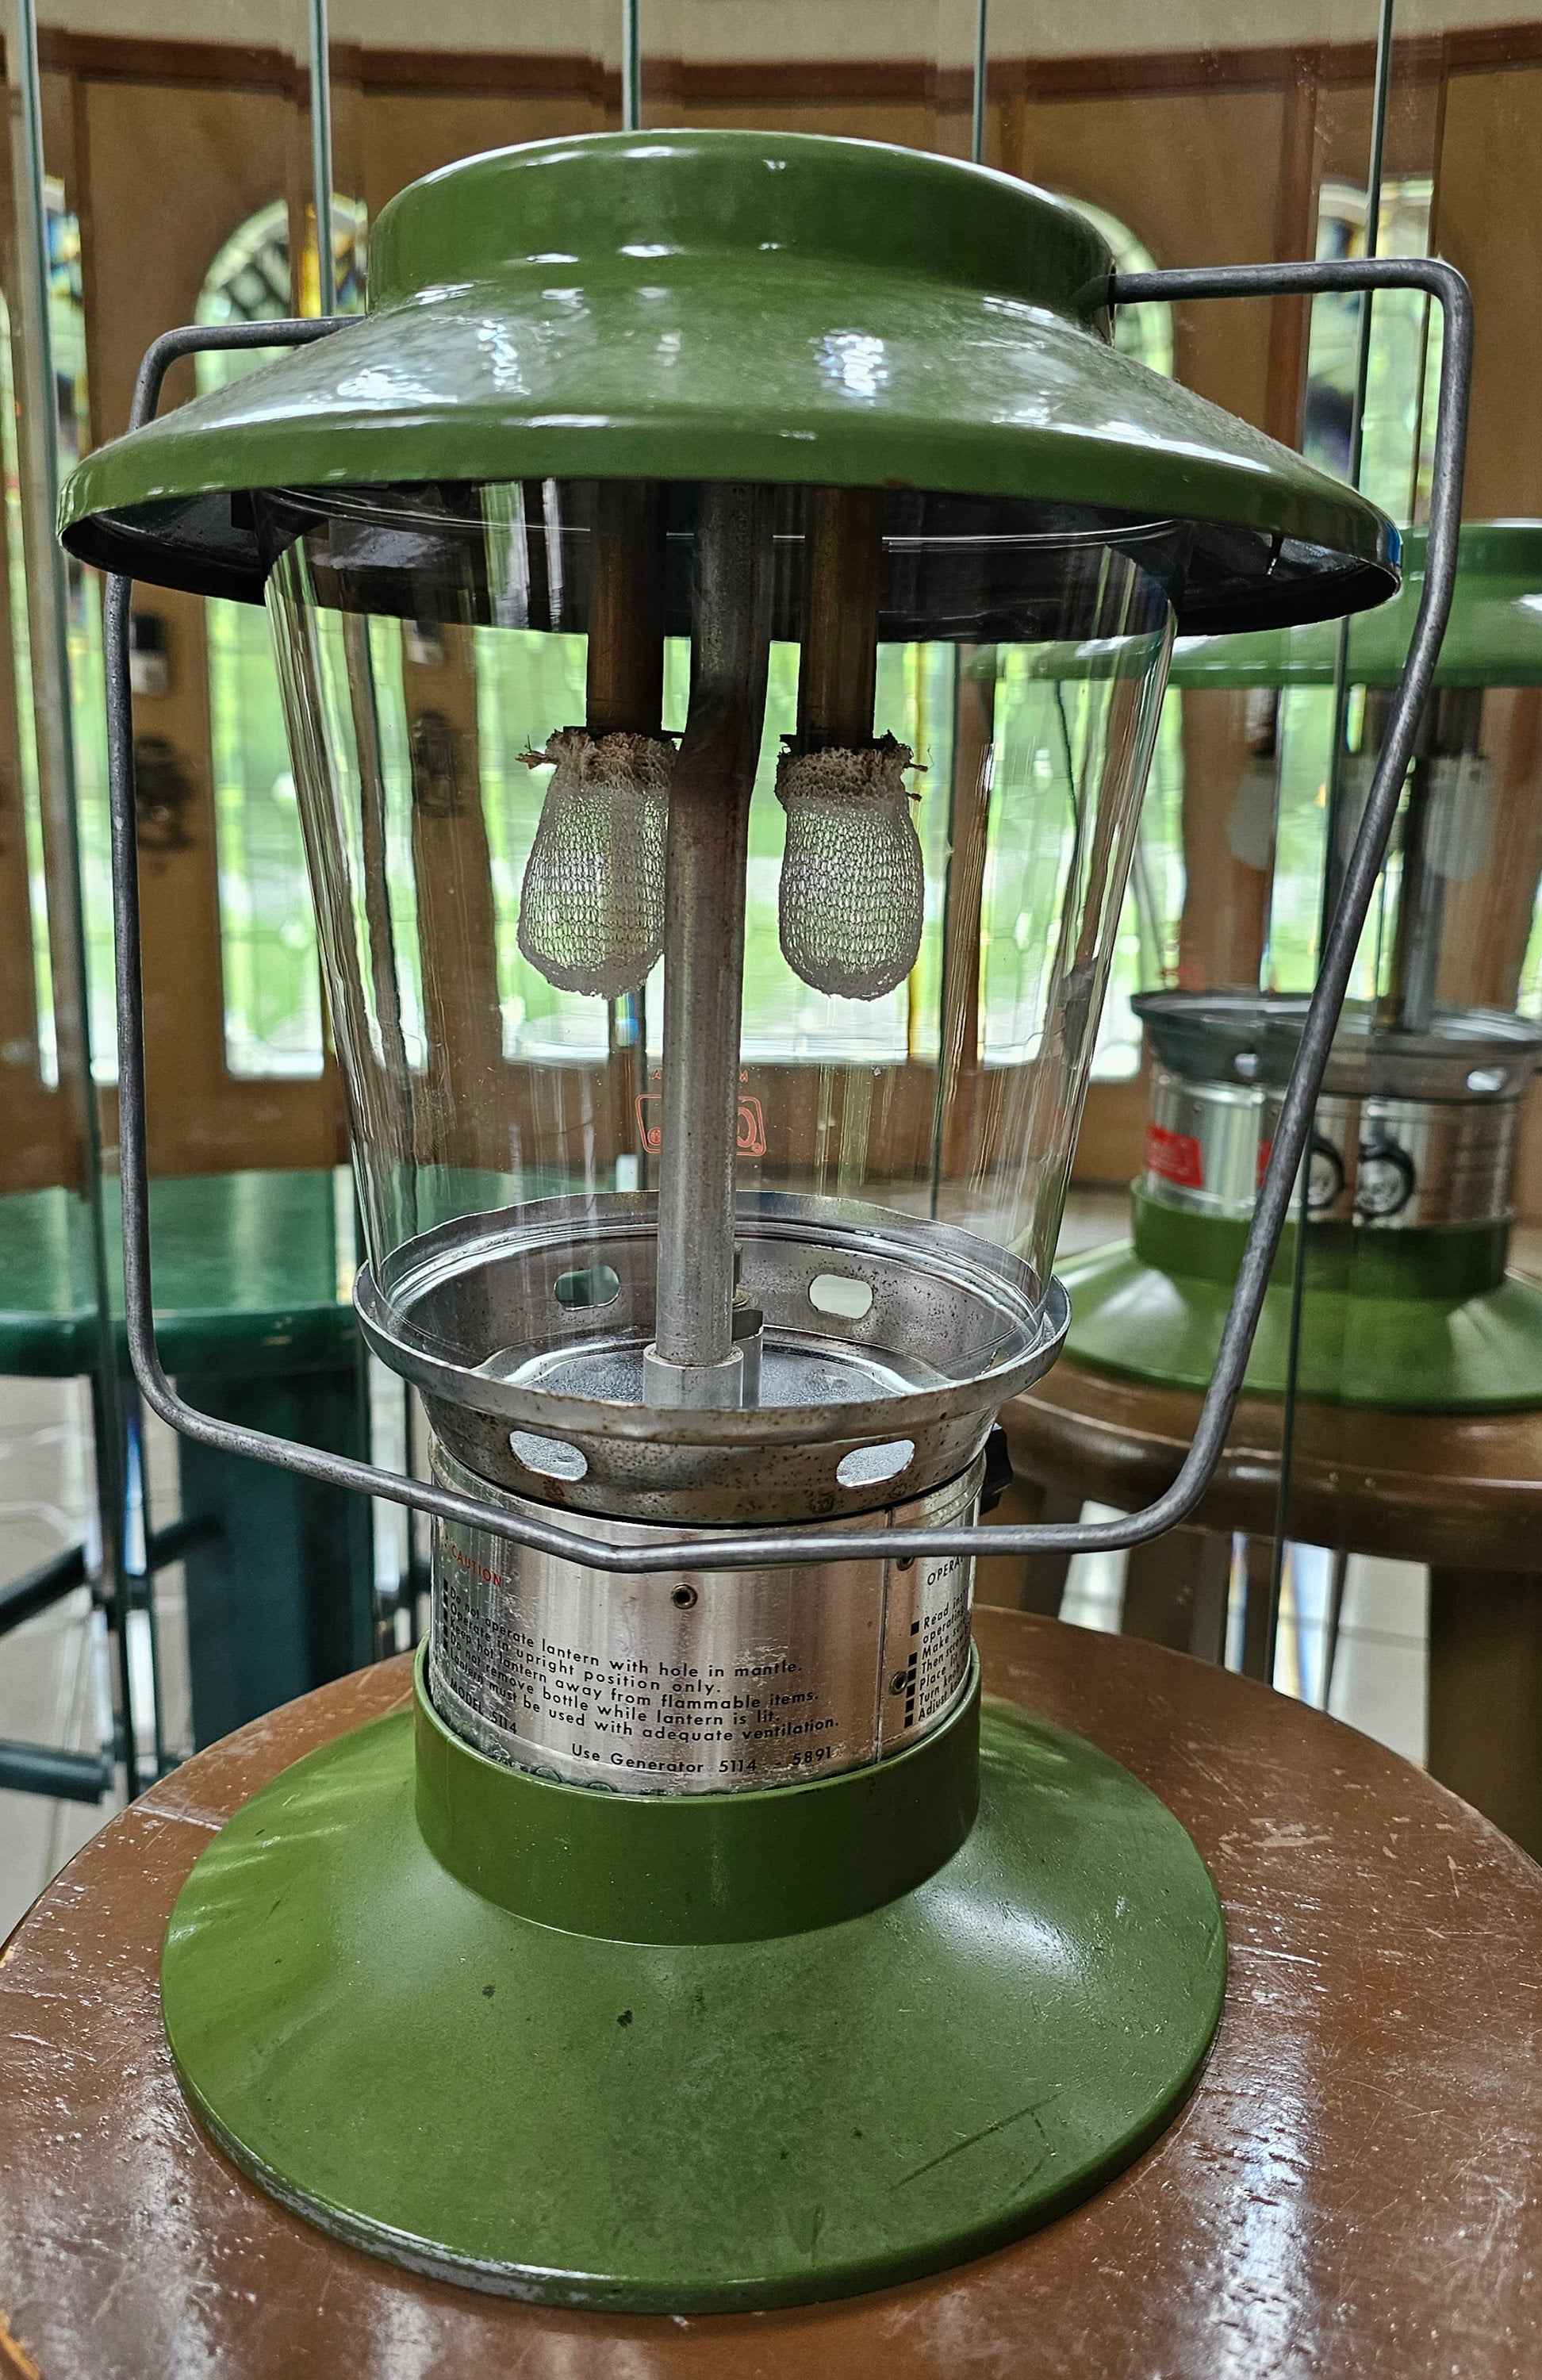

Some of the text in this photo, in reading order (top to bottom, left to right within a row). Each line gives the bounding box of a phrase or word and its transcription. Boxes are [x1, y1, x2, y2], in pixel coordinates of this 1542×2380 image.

[451, 1545, 501, 1587] CAUTION
[451, 1587, 802, 1677] Do not operate lantern with hole in mantle.
[923, 1602, 949, 1630] Read
[451, 1603, 721, 1695] Operate in upright position only.
[921, 1654, 943, 1674] Then
[922, 1635, 949, 1660] Make
[466, 1650, 481, 1667] not
[486, 1664, 534, 1695] remove
[543, 1686, 589, 1710] bottle
[597, 1704, 646, 1721] while
[657, 1710, 723, 1726] lantern
[733, 1712, 746, 1725] is
[757, 1710, 780, 1722] lit.
[500, 1651, 547, 1683] lantern
[555, 1679, 602, 1700] away
[611, 1688, 650, 1706] from
[662, 1694, 761, 1709] flammable
[769, 1691, 819, 1706] items.
[919, 1686, 940, 1706] Turn
[920, 1666, 946, 1691] Place
[451, 1678, 517, 1734] MODEL 5114
[489, 1682, 517, 1703] must
[524, 1694, 540, 1713] be
[549, 1708, 585, 1726] used
[594, 1721, 632, 1736] with
[642, 1726, 733, 1743] adequate
[742, 1718, 839, 1740] ventilation.
[918, 1691, 948, 1722] Adjust
[572, 1743, 600, 1761] Use
[611, 1752, 704, 1773] Generator
[719, 1760, 757, 1773] 5114
[793, 1746, 831, 1766] 5891
